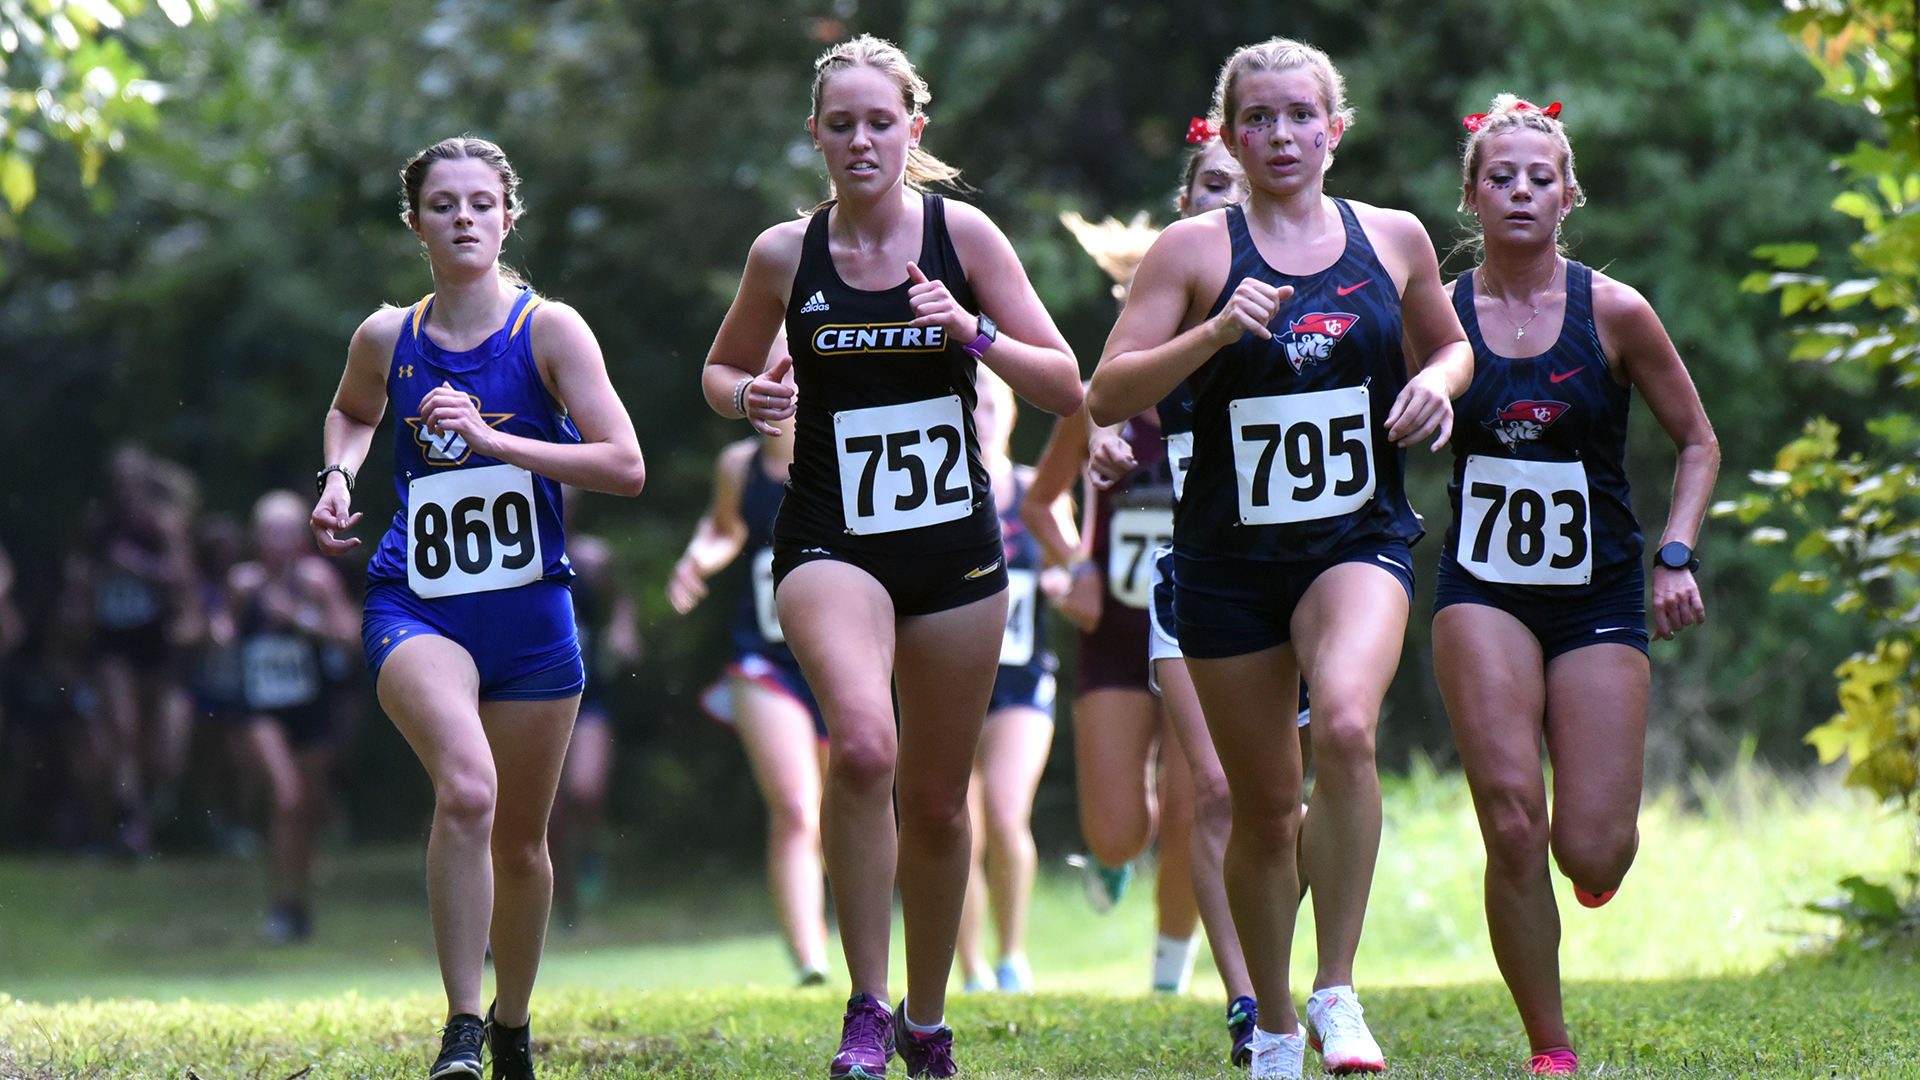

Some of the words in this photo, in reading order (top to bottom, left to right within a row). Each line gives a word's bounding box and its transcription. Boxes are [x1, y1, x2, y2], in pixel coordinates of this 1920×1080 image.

[800, 303, 830, 314] adidas
[1323, 319, 1342, 336] UC
[816, 326, 942, 350] CENTRE
[1532, 406, 1551, 422] UC
[845, 424, 970, 518] 752
[1241, 414, 1369, 507] 795
[415, 491, 535, 580] 869
[1470, 481, 1588, 570] 783
